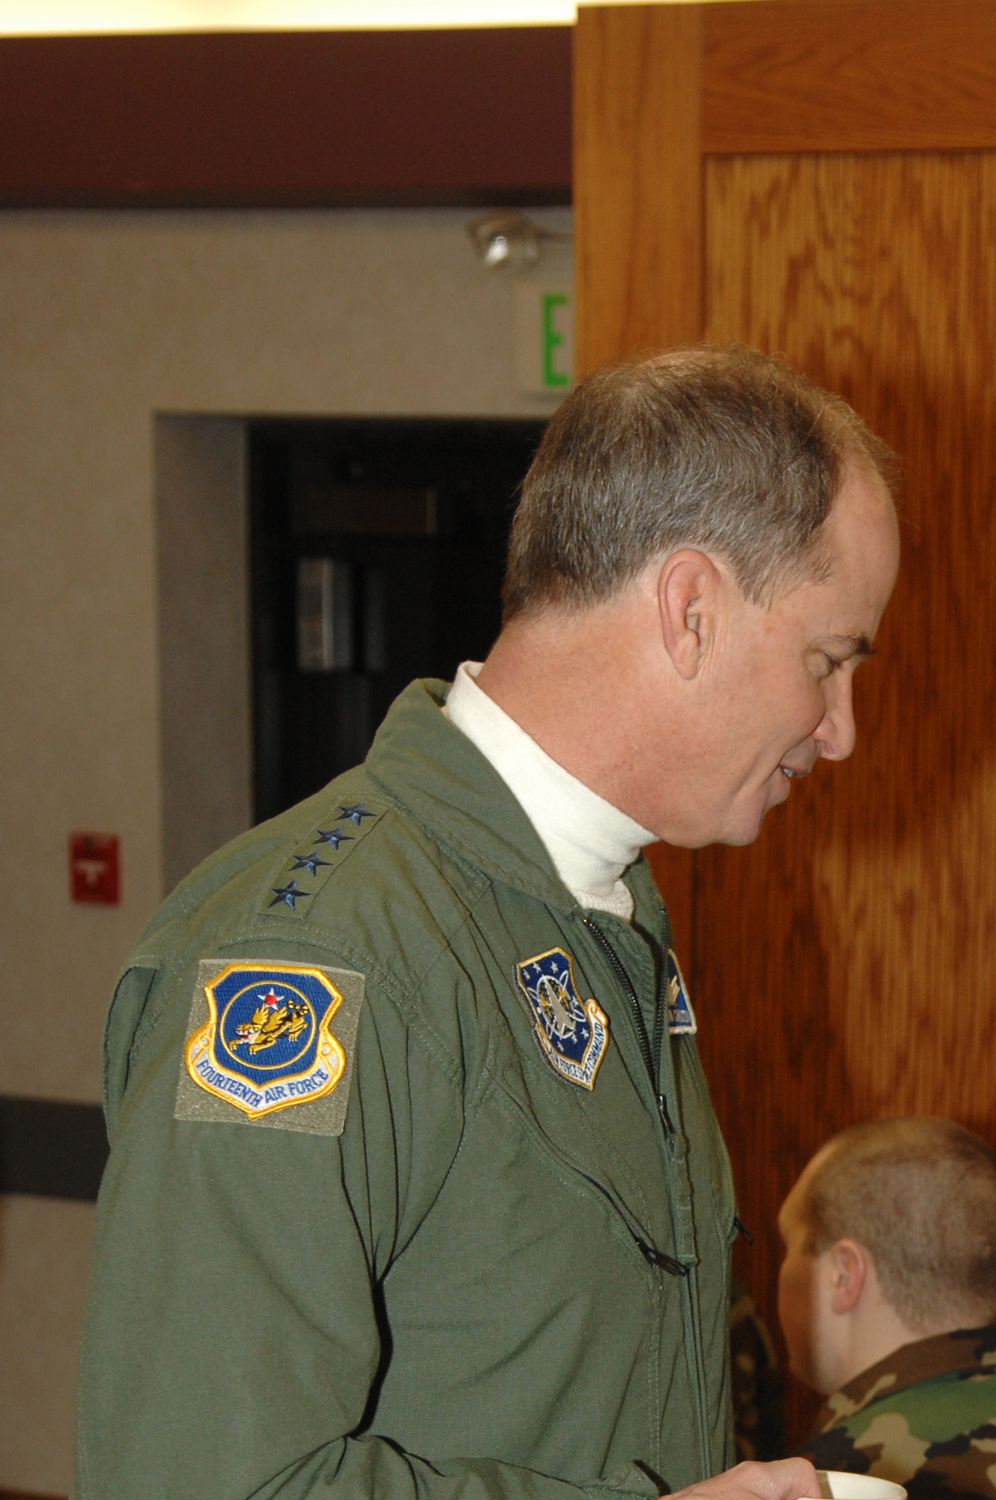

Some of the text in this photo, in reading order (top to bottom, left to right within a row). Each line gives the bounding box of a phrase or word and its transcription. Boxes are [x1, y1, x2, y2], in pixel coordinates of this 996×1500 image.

[587, 1022, 604, 1069] COMMAND
[196, 1059, 329, 1108] FOURTEENTH AIR FORCE
